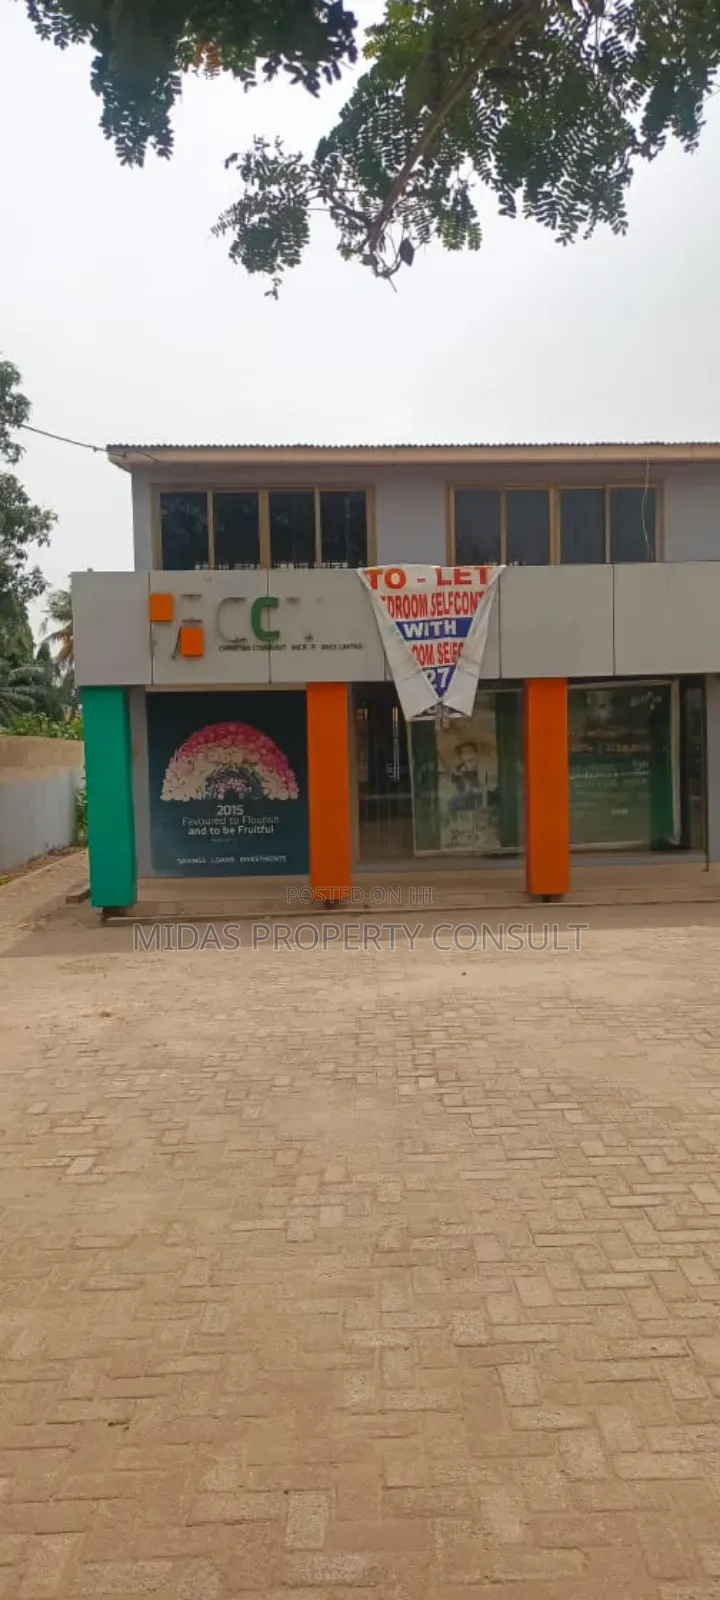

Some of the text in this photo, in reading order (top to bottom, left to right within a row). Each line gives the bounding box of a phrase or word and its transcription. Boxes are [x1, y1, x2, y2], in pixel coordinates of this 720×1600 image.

[364, 567, 407, 590] TO
[435, 566, 493, 587] LET
[403, 619, 457, 638] WITH
[216, 804, 244, 816] 2015
[182, 815, 280, 827] Favoured to Flourish
[188, 825, 274, 836] and to be Fruitful
